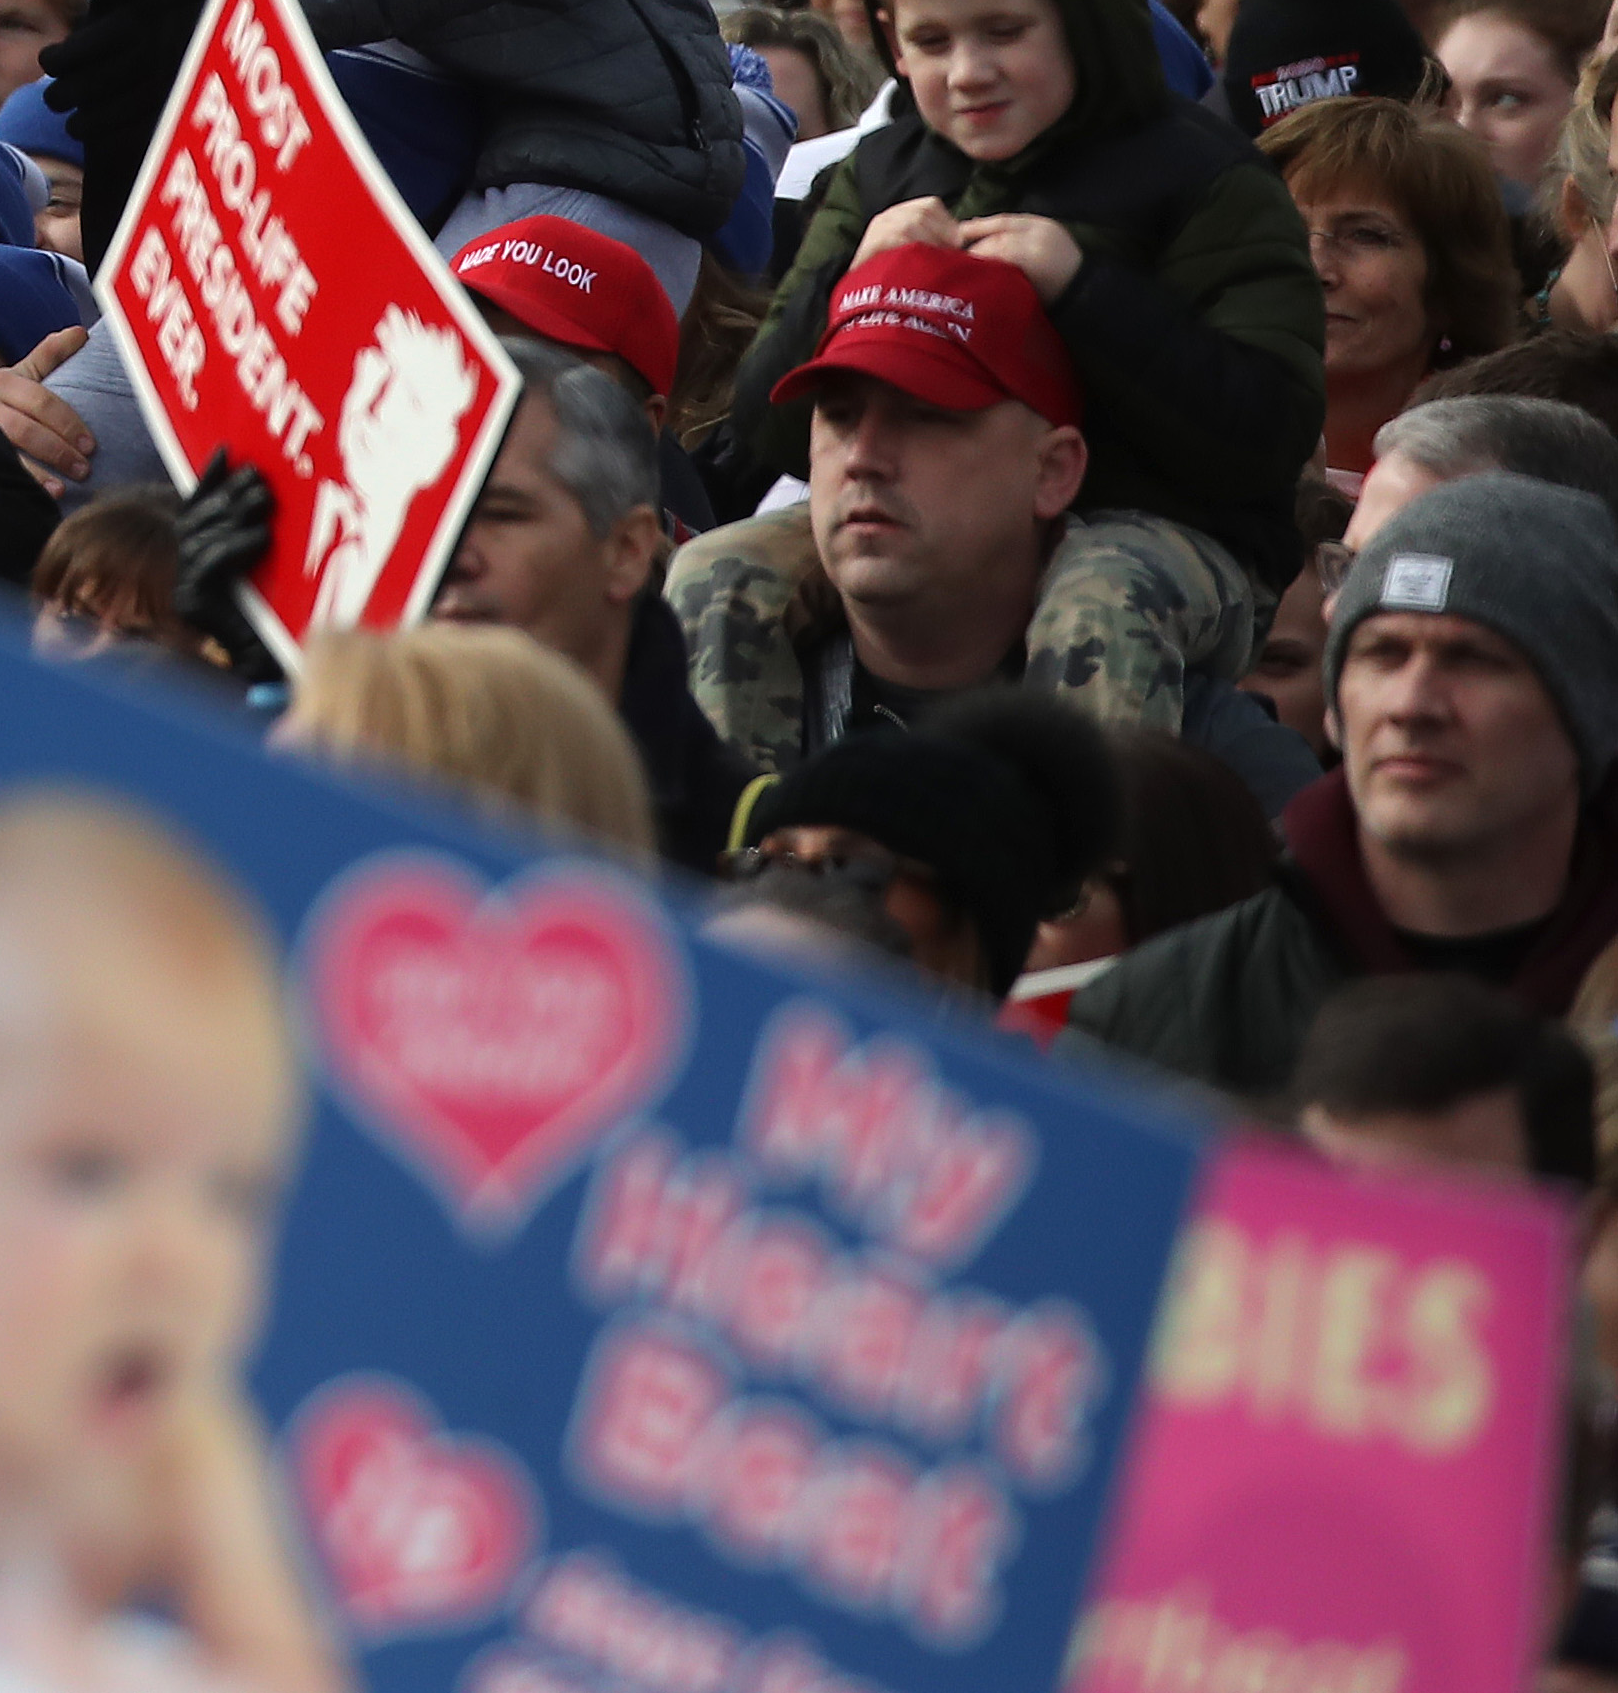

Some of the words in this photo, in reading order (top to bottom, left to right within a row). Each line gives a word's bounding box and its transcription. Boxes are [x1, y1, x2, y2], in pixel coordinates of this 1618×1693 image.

[1255, 65, 1358, 118] TRUMP
[191, 70, 322, 338] PRO-LIFE
[458, 242, 501, 274] MADE
[501, 239, 543, 265] YOU
[541, 250, 598, 294] LOOK
[129, 225, 207, 412] EVER.
[159, 146, 325, 480] PRESIDENT.
[883, 286, 975, 320] AMERICA
[1149, 1215, 1496, 1461] BIES
